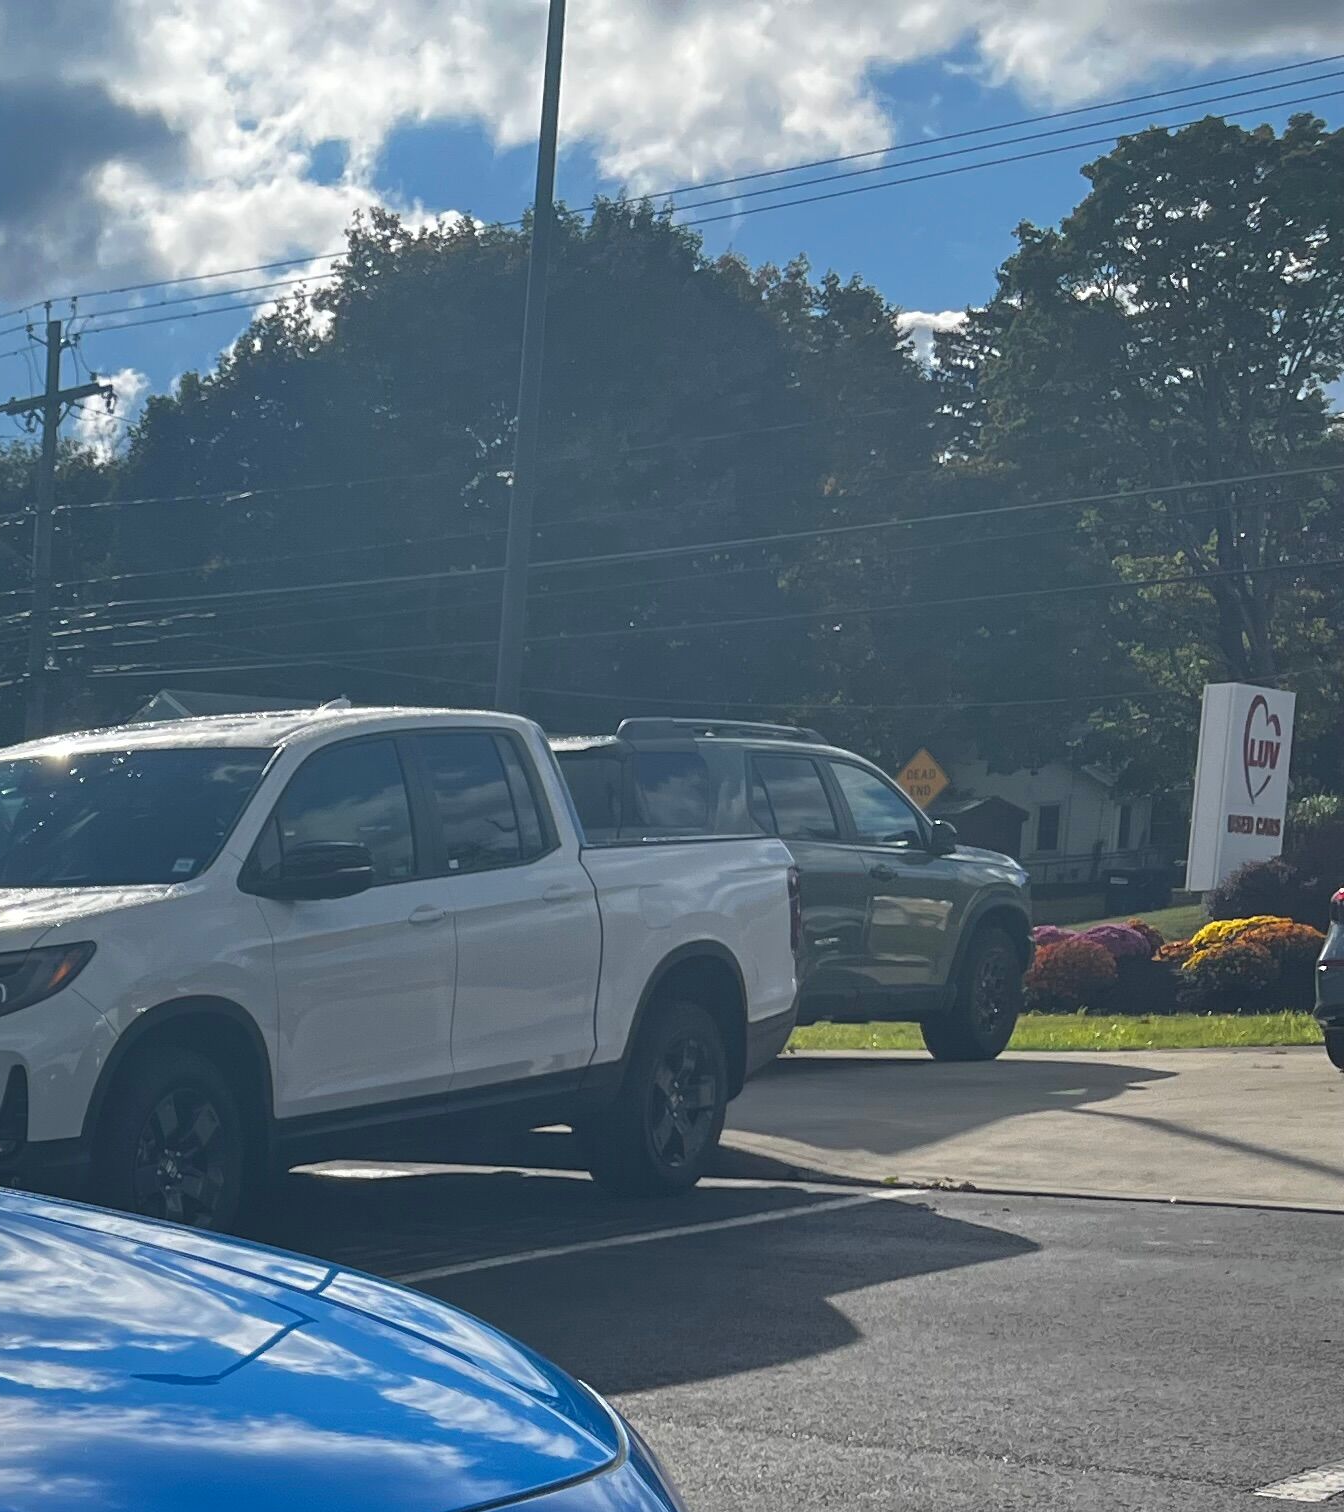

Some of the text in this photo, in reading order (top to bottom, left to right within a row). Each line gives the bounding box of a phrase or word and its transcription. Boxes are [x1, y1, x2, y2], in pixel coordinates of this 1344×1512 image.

[1247, 738, 1281, 770] LUV
[906, 768, 936, 780] DEAD
[910, 784, 931, 796] END
[1227, 814, 1281, 836] USED CARS
